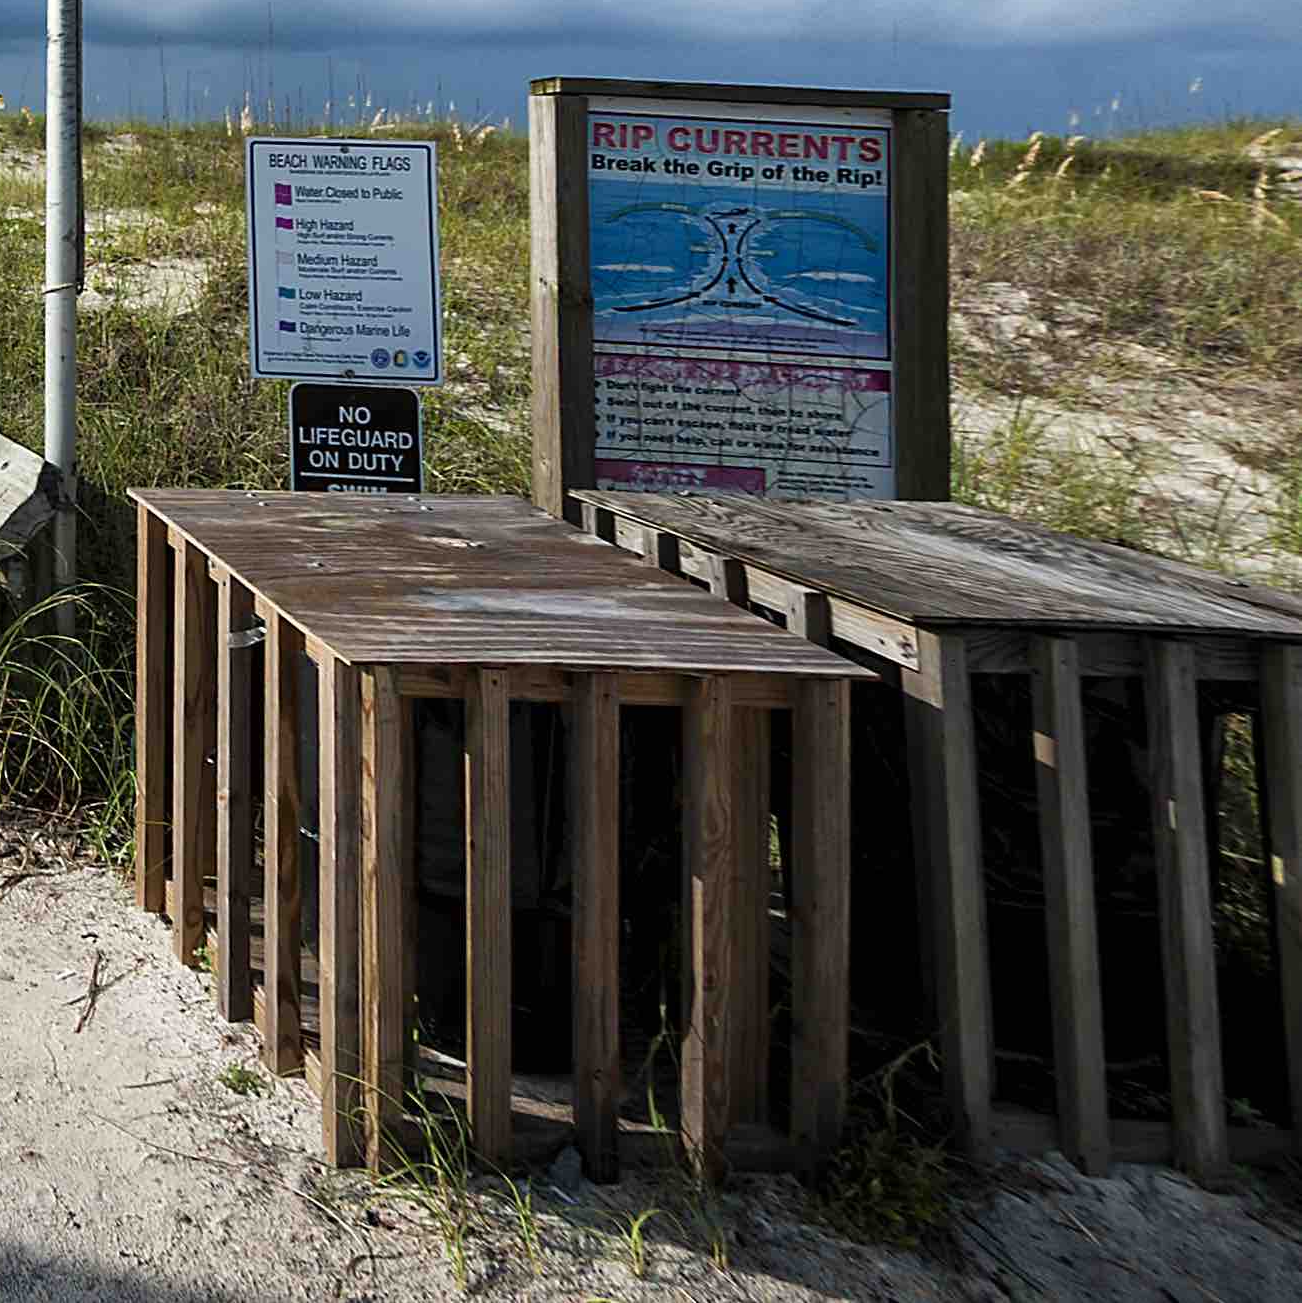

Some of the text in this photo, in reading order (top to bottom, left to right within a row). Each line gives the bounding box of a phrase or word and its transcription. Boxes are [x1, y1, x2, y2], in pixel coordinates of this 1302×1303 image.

[592, 121, 883, 163] RIP CURRENTS
[269, 154, 411, 171] BEACH WARNING FLAGS
[591, 154, 883, 189] Break the Grip of the Rip!
[295, 186, 403, 200] Water Closed to Public
[296, 219, 354, 232] High Hazard
[297, 253, 378, 267] Medium Hazard
[299, 288, 362, 302] Low Hazard
[300, 322, 411, 337] Dangerous Marine Life
[641, 381, 670, 393] fight
[672, 383, 693, 394] the
[339, 406, 371, 424] NO
[607, 396, 639, 407] Swim
[643, 400, 663, 409] out
[665, 401, 679, 410] of
[681, 402, 702, 412] the
[759, 406, 787, 417] then
[789, 408, 804, 418] to
[607, 412, 616, 423] If
[619, 415, 642, 426] you
[643, 415, 674, 426] can't
[299, 426, 413, 449] LIFEGUARD
[607, 429, 616, 439] If
[619, 432, 641, 443] you
[644, 433, 674, 443] need
[710, 437, 732, 446] call
[736, 439, 749, 447] or
[788, 441, 805, 450] for
[309, 450, 403, 472] ON DUTY
